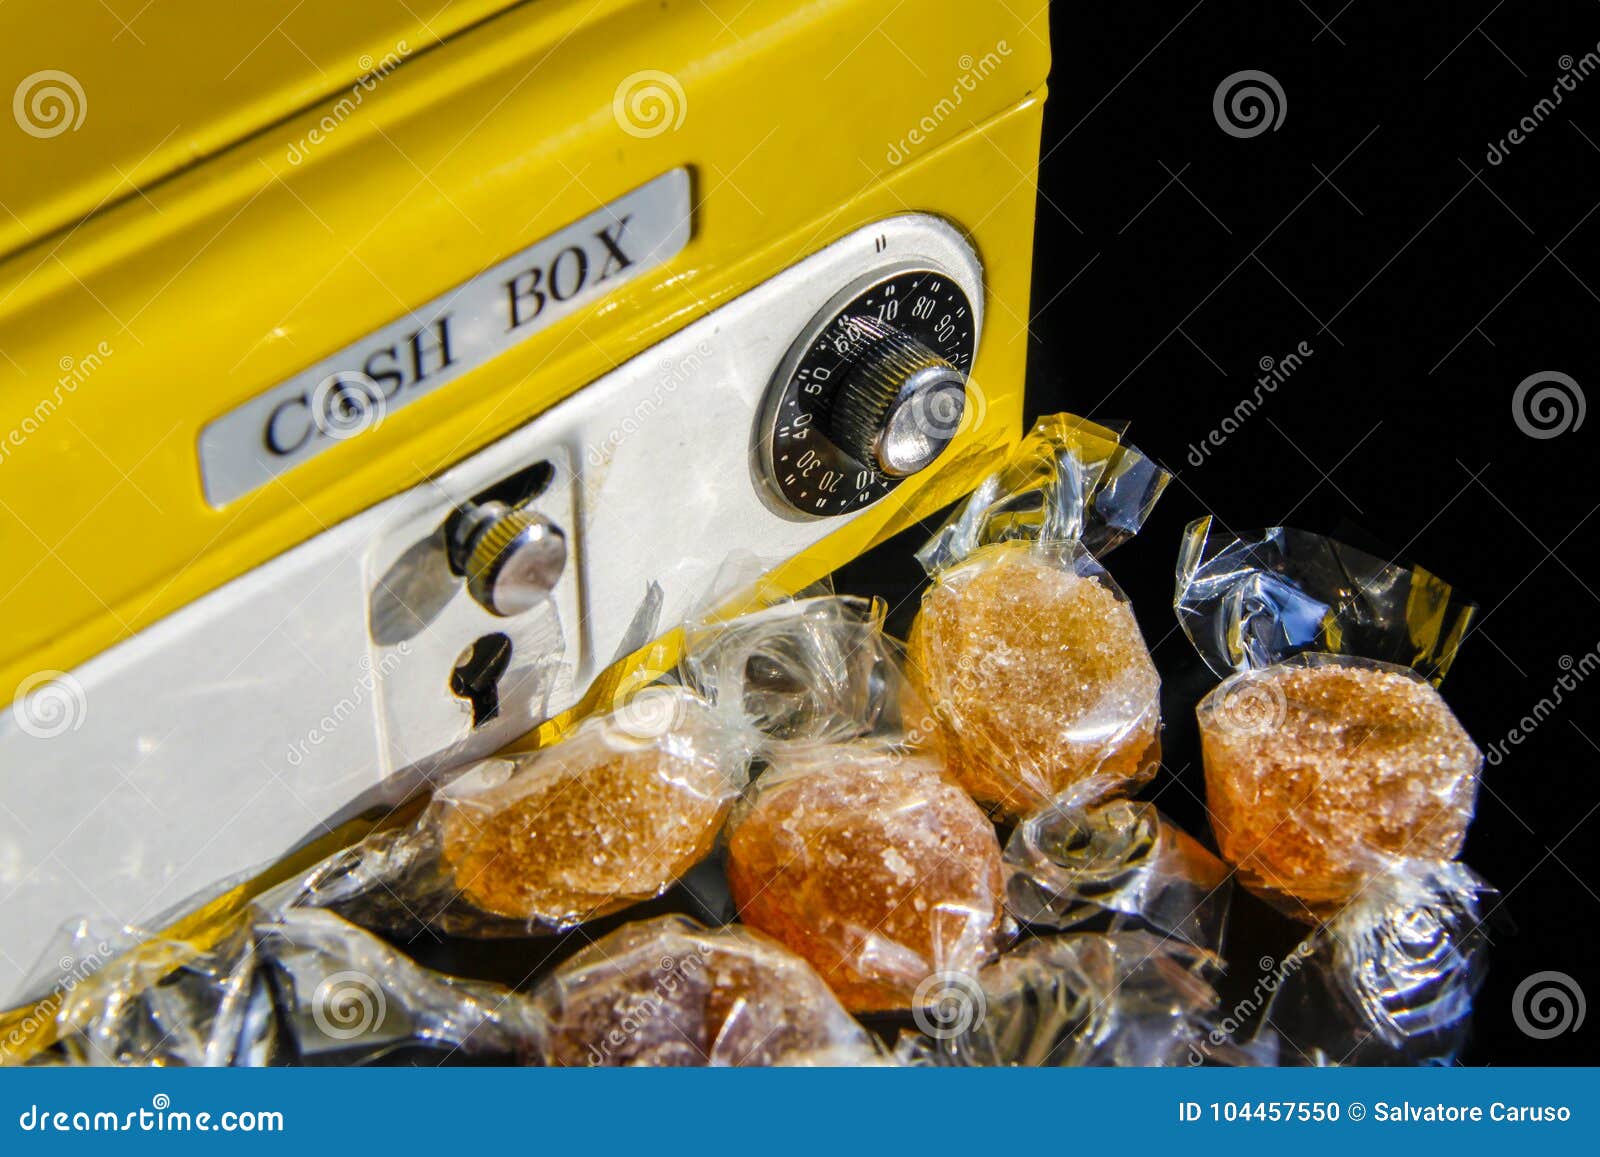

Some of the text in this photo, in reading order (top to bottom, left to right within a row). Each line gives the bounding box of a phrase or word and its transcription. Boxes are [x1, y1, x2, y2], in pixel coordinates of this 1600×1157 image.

[877, 299, 899, 326] 70
[911, 296, 936, 320] 80
[263, 214, 635, 458] CASH BOX
[833, 322, 861, 353] 60
[934, 314, 955, 342] 90
[804, 367, 831, 395] 50
[792, 412, 813, 440] 40
[796, 449, 822, 478] 30
[818, 470, 844, 494] 20
[855, 473, 876, 490] 10
